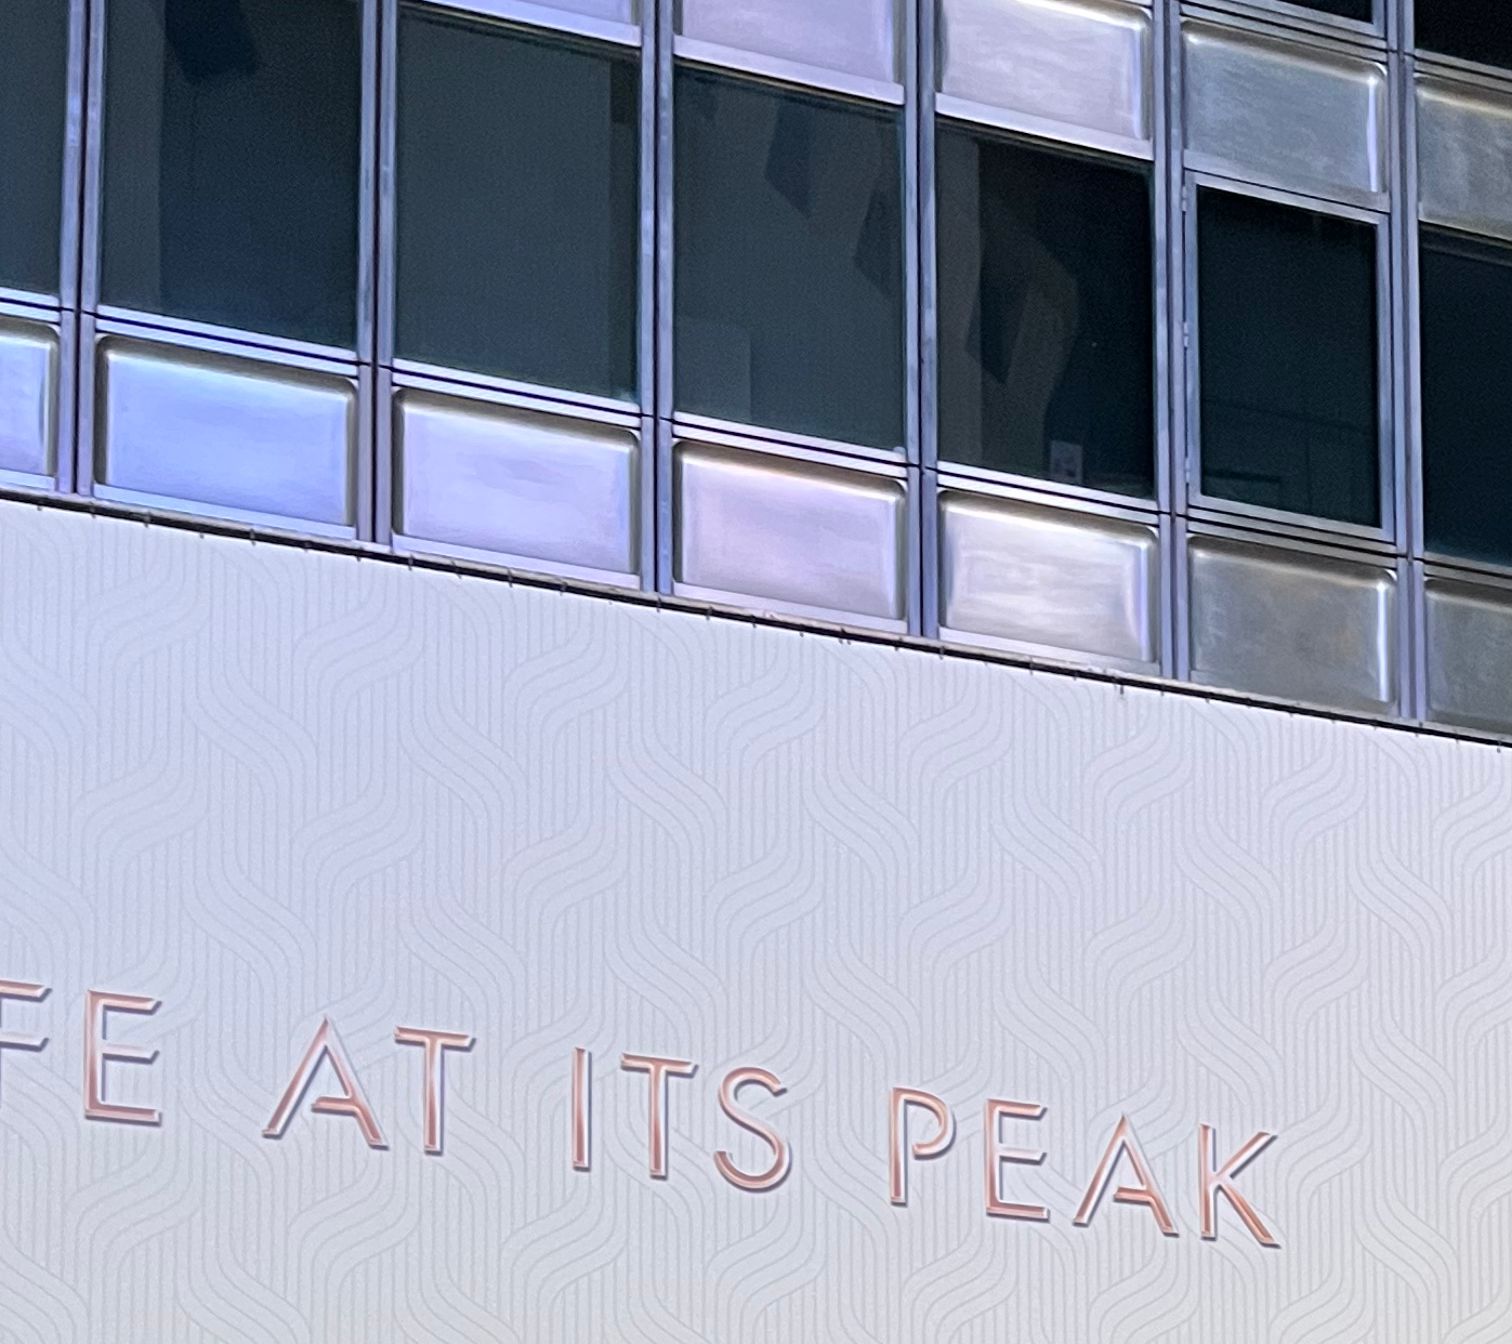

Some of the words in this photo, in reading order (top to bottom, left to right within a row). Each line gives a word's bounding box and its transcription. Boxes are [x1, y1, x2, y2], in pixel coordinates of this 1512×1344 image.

[262, 1013, 477, 1156] AT
[570, 1046, 791, 1193] ITS
[889, 1086, 1281, 1249] PEAK
